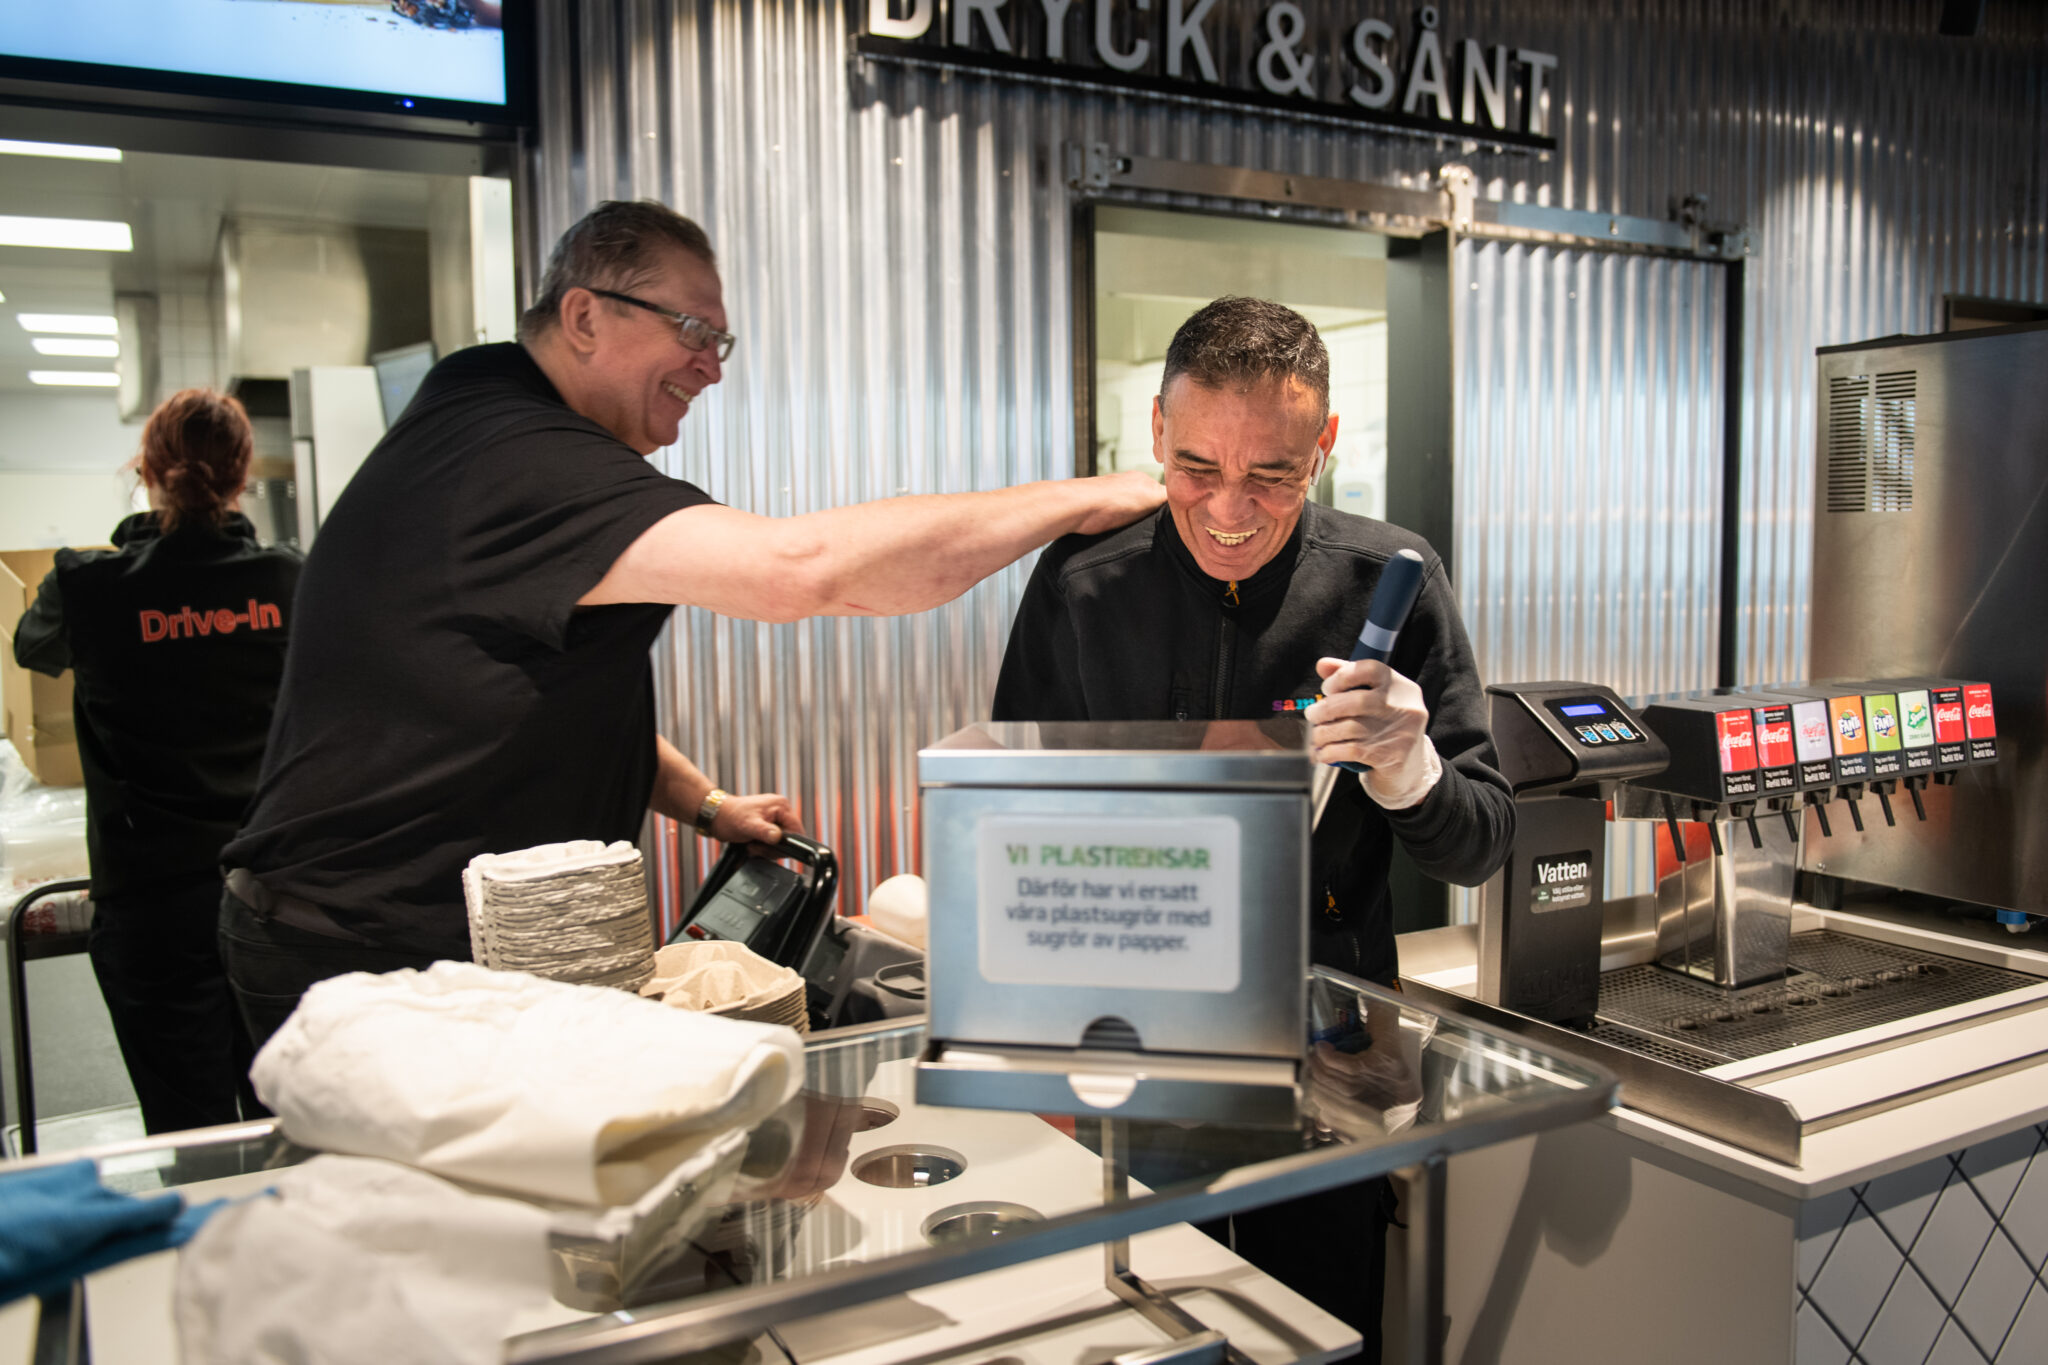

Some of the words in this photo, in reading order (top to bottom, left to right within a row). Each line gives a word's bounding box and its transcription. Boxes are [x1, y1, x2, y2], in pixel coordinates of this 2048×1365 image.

[1255, 1, 1316, 98] &
[1350, 6, 1560, 135] SÅNT
[139, 599, 282, 642] Drive-In
[1272, 694, 1323, 711] sam
[1006, 844, 1028, 865] VI
[1040, 845, 1211, 870] PLASTRENSAR
[1537, 862, 1587, 884] Vatten
[1018, 878, 1077, 898] Därför
[1082, 880, 1113, 898] har
[1118, 881, 1135, 899] vi
[1138, 883, 1198, 901] ersatt
[1006, 903, 1047, 922] våra
[1051, 904, 1163, 928] plastsugrör
[1167, 908, 1211, 927] med
[1027, 930, 1088, 949] sugrör
[1093, 933, 1115, 948] av
[1118, 934, 1189, 952] papper.
